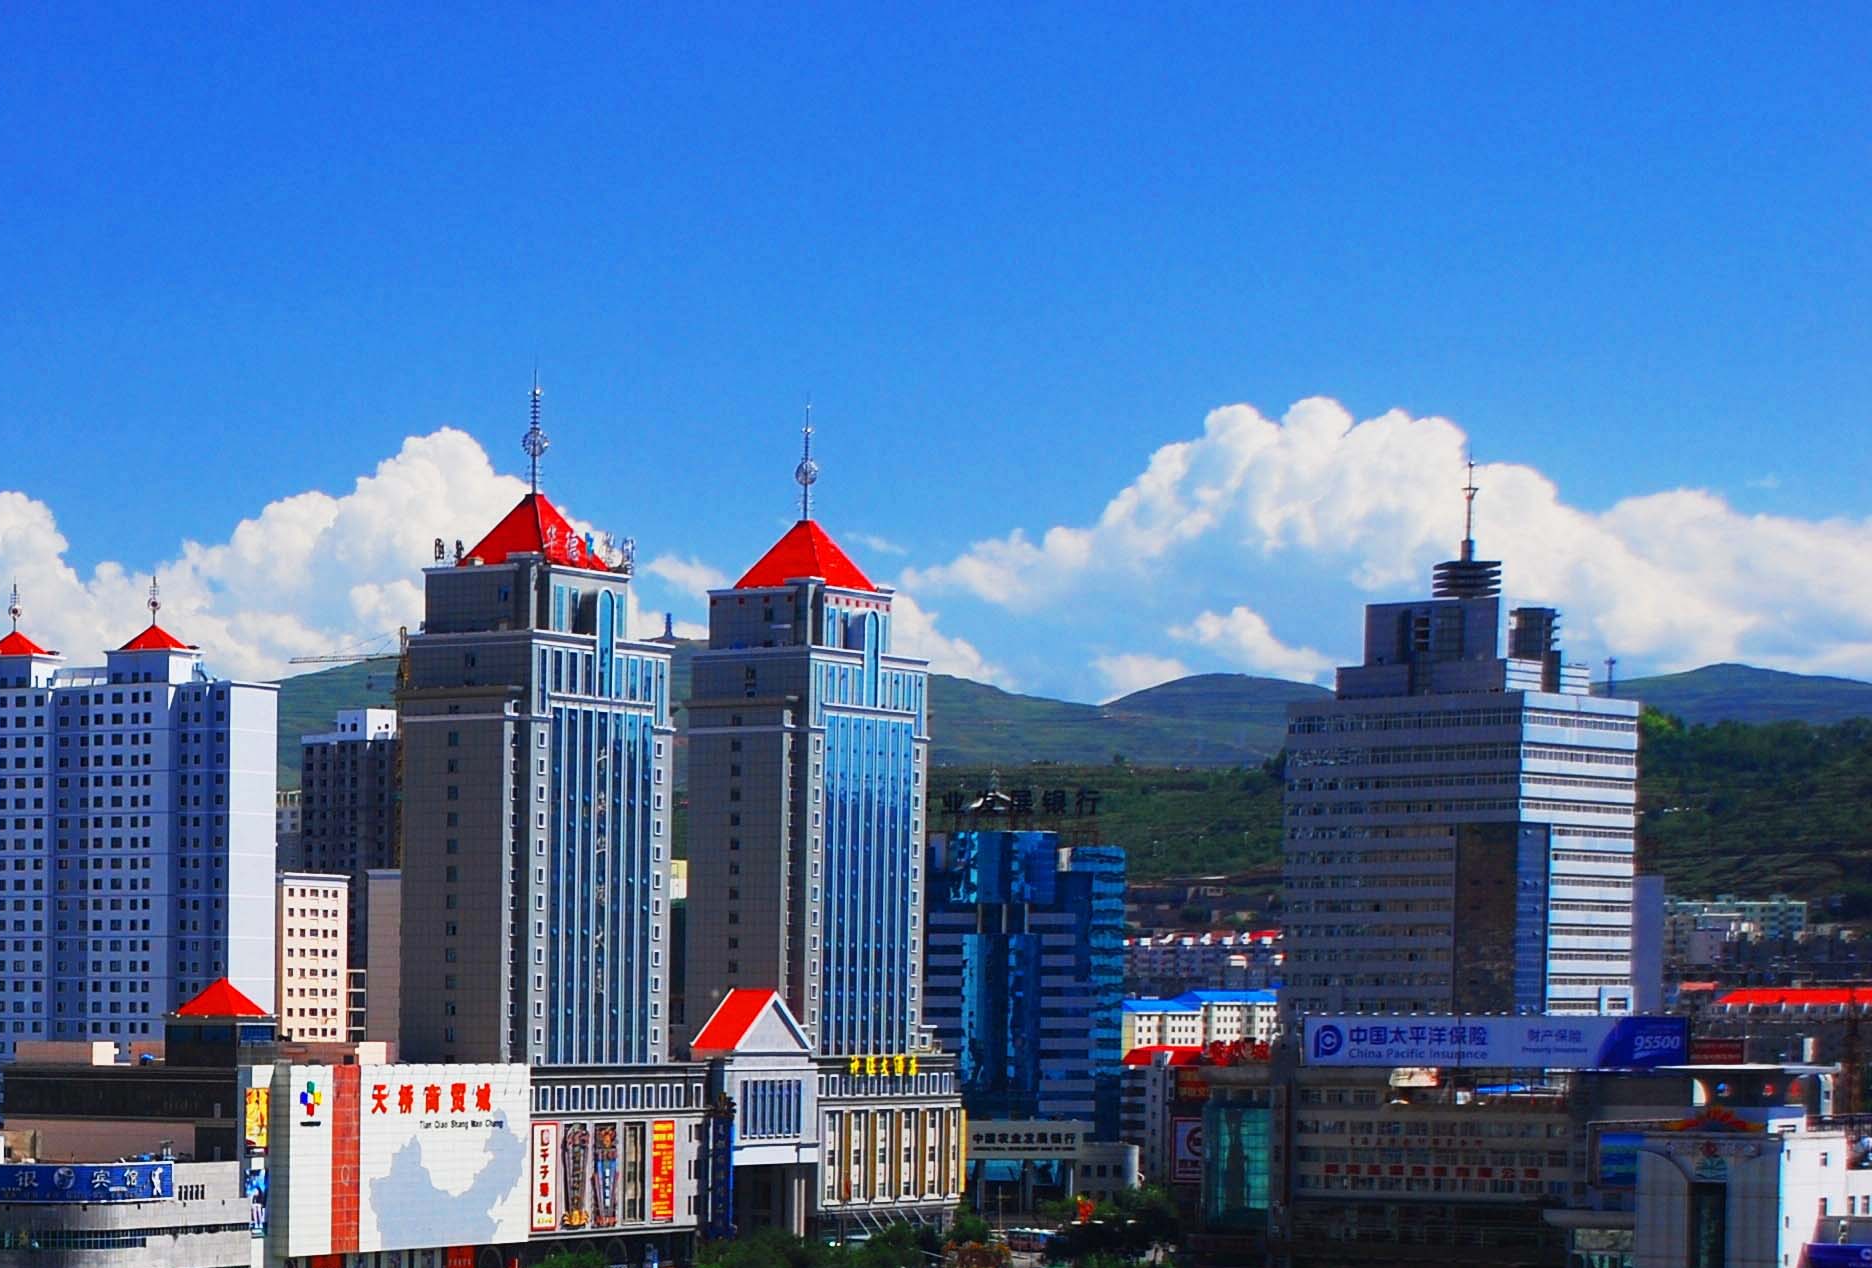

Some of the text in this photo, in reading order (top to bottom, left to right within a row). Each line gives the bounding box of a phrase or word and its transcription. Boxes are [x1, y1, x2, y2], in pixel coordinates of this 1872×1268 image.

[928, 789, 1100, 815] 业发展银行
[1349, 1026, 1488, 1046] 中国太平洋保险
[1634, 1035, 1681, 1050] 95500
[1349, 1048, 1488, 1060] China Pacific Insurance
